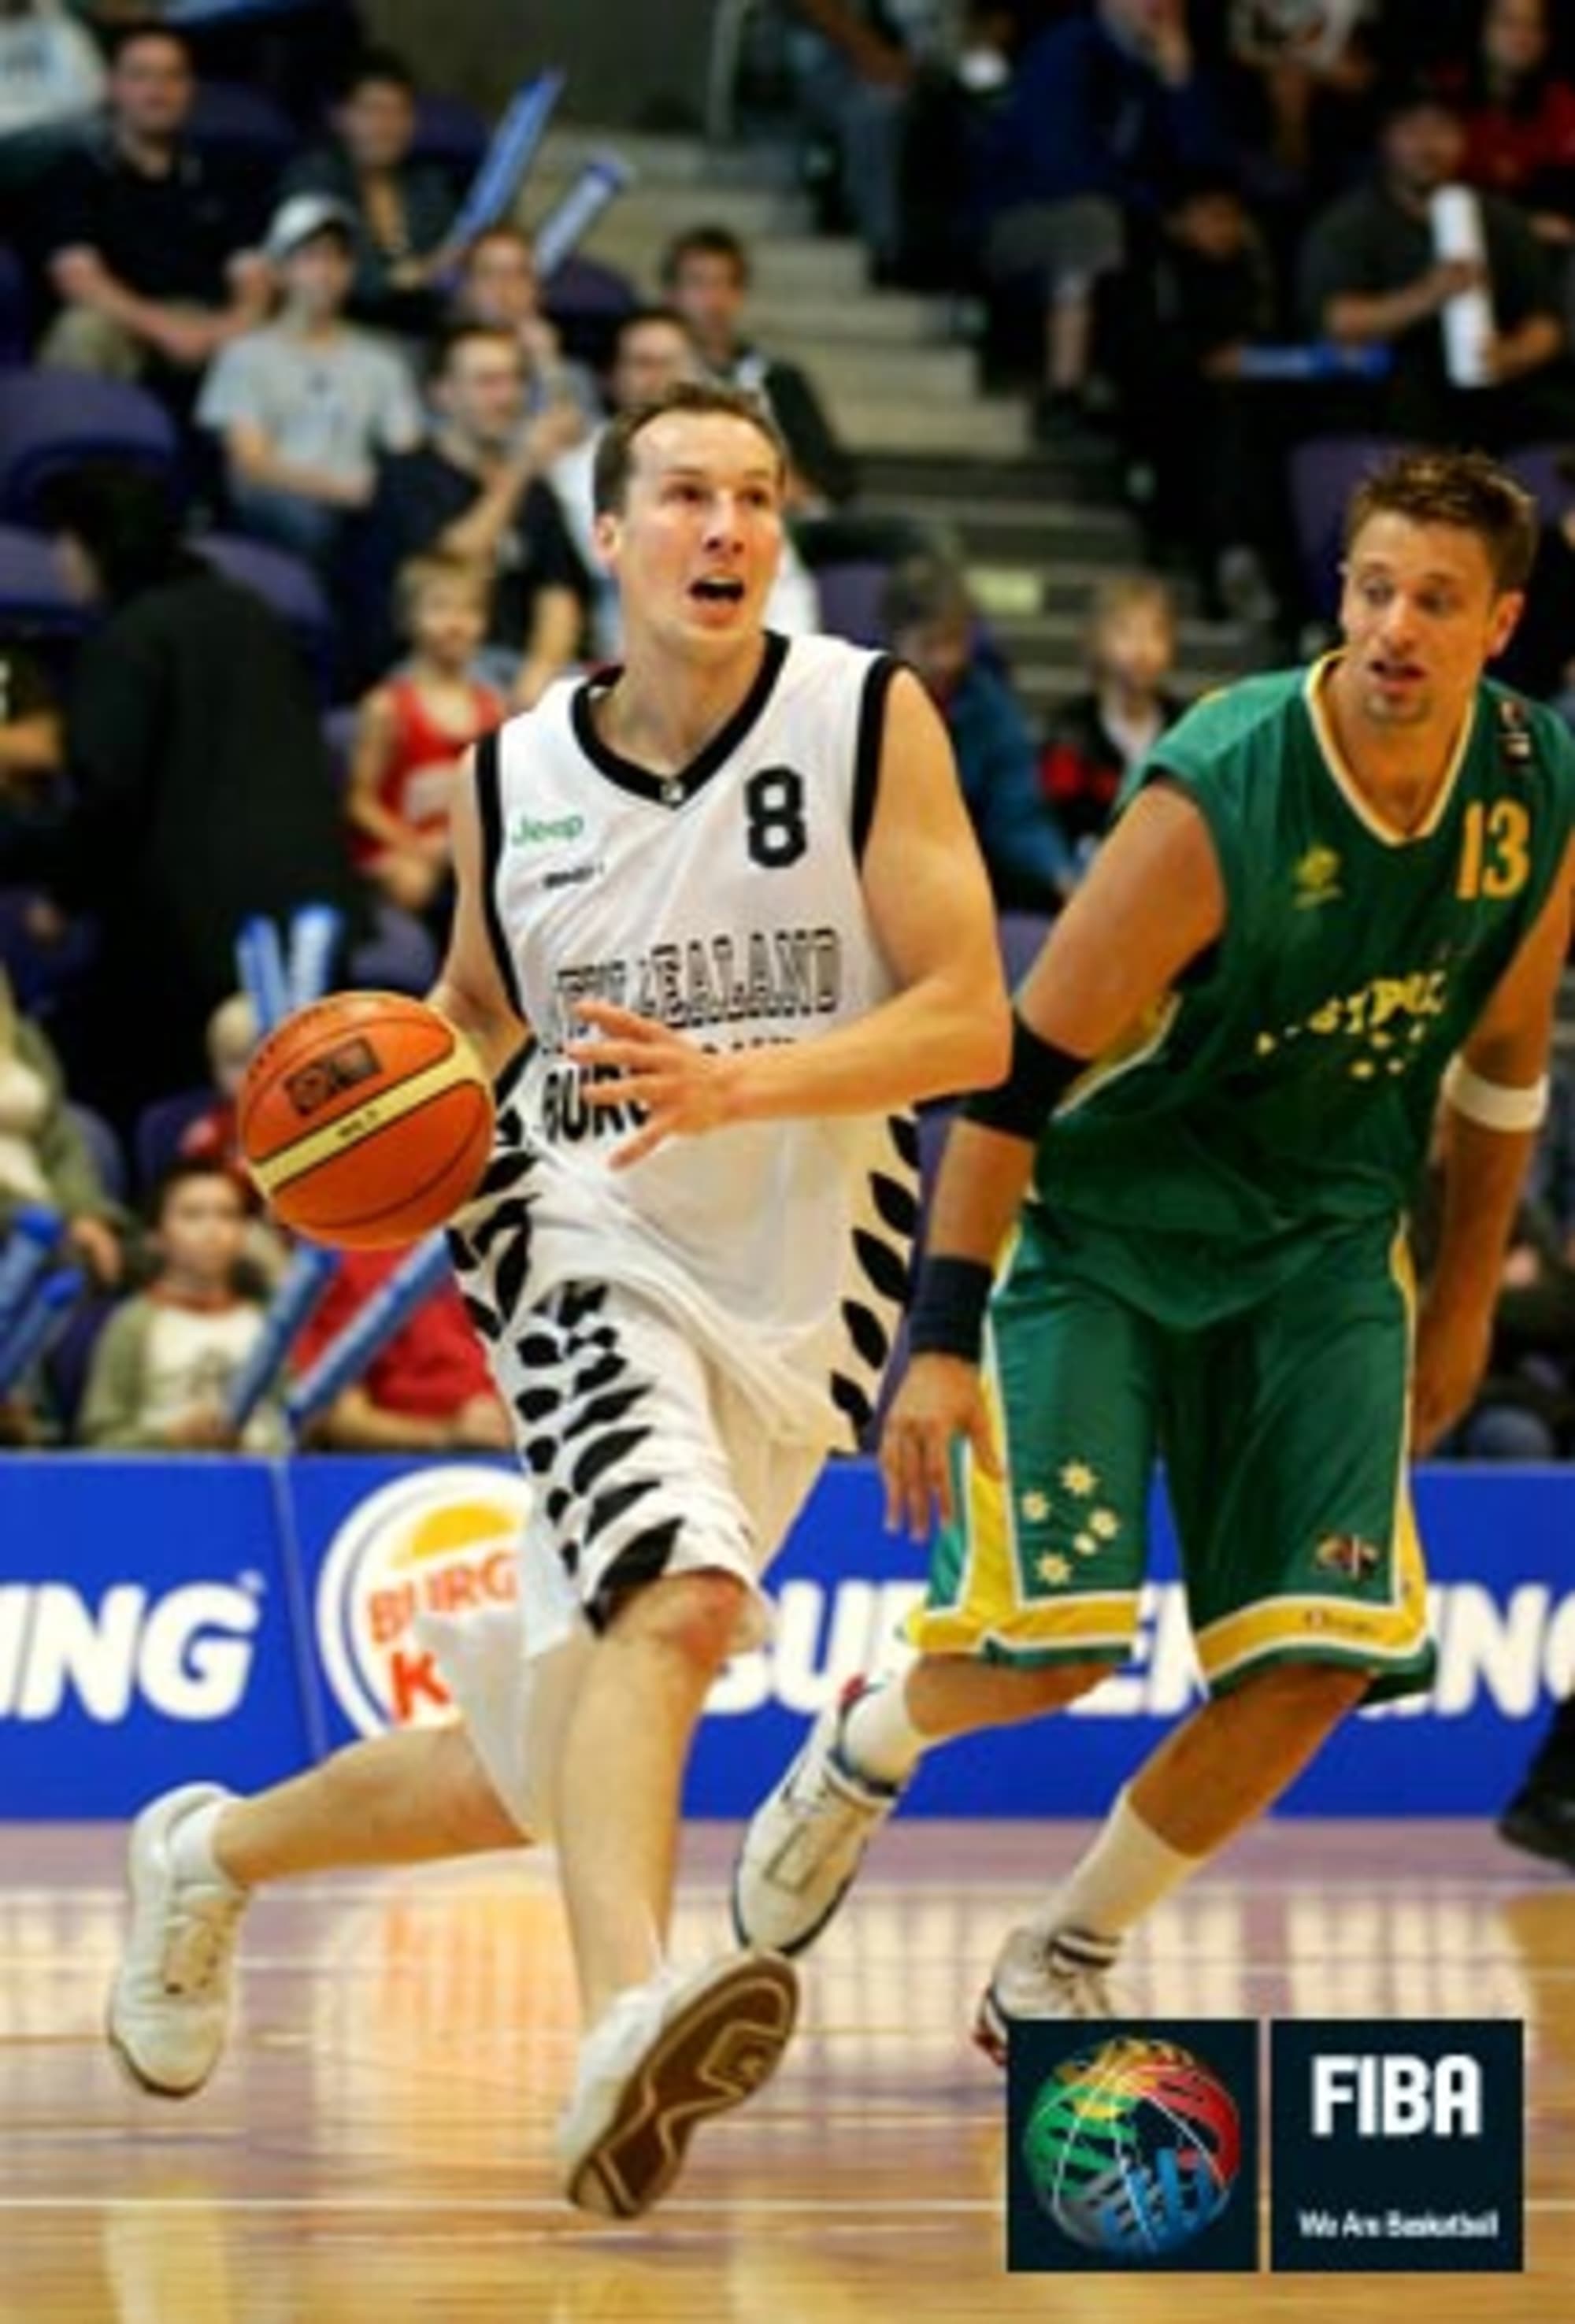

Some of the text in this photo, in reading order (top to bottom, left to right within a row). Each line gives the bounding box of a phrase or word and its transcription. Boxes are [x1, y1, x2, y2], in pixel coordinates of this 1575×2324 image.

[744, 765, 806, 867] 8
[1457, 799, 1530, 899] 13
[368, 1549, 517, 1644] BURG
